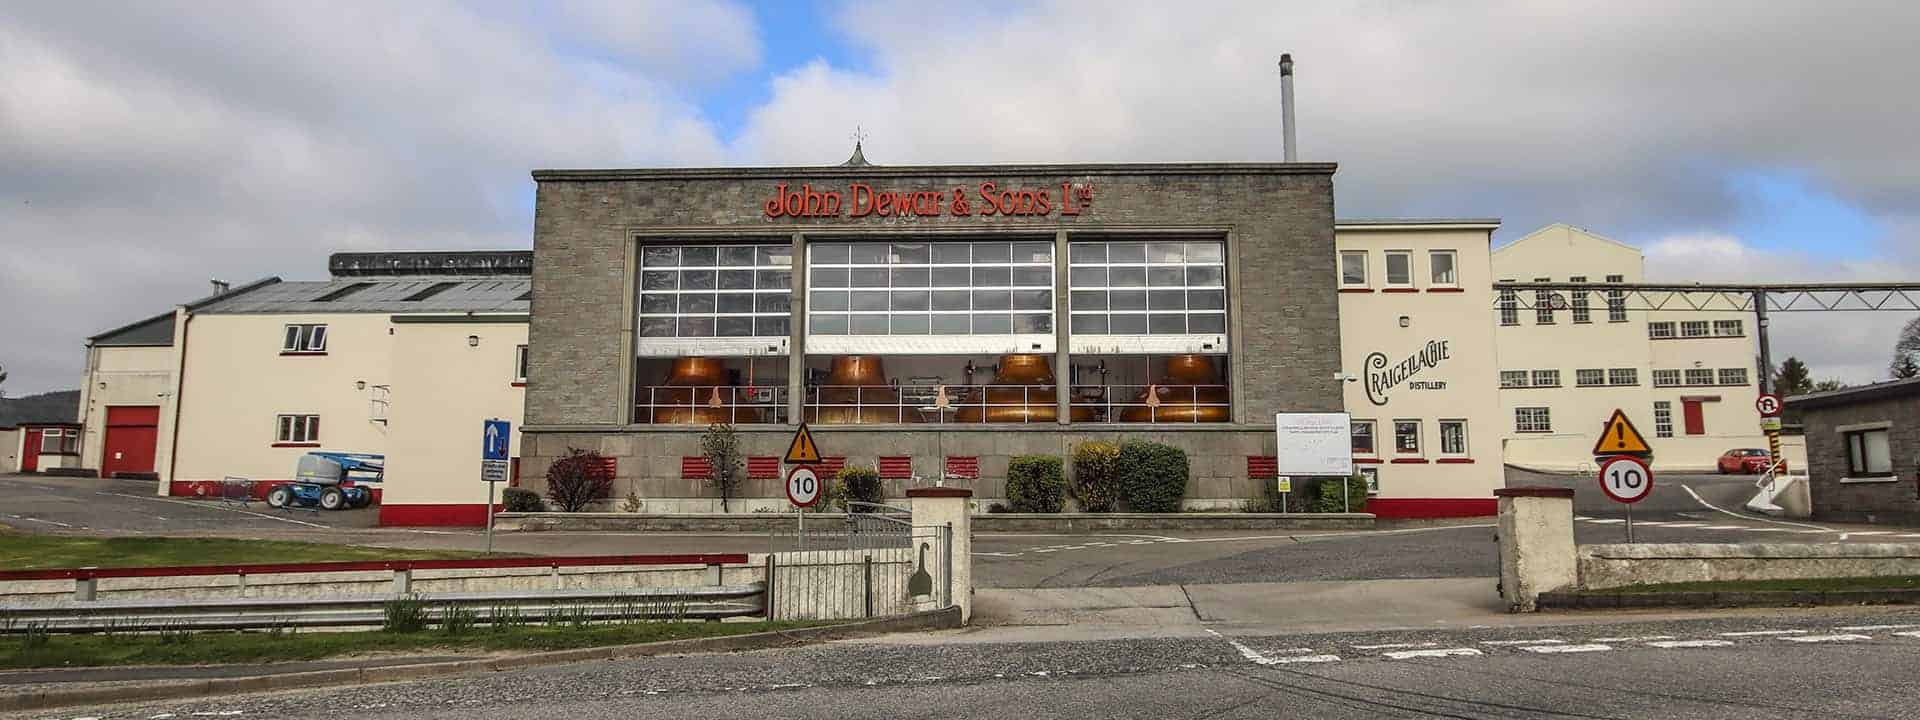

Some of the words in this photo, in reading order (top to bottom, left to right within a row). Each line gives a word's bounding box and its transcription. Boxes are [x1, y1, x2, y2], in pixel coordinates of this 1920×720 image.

[766, 182, 841, 217] John
[850, 183, 944, 216] Dewar
[951, 187, 971, 216] &
[979, 181, 1051, 216] Sons
[1409, 381, 1447, 390] DISTILLERY
[794, 477, 814, 494] 10
[1611, 469, 1642, 489] 10
